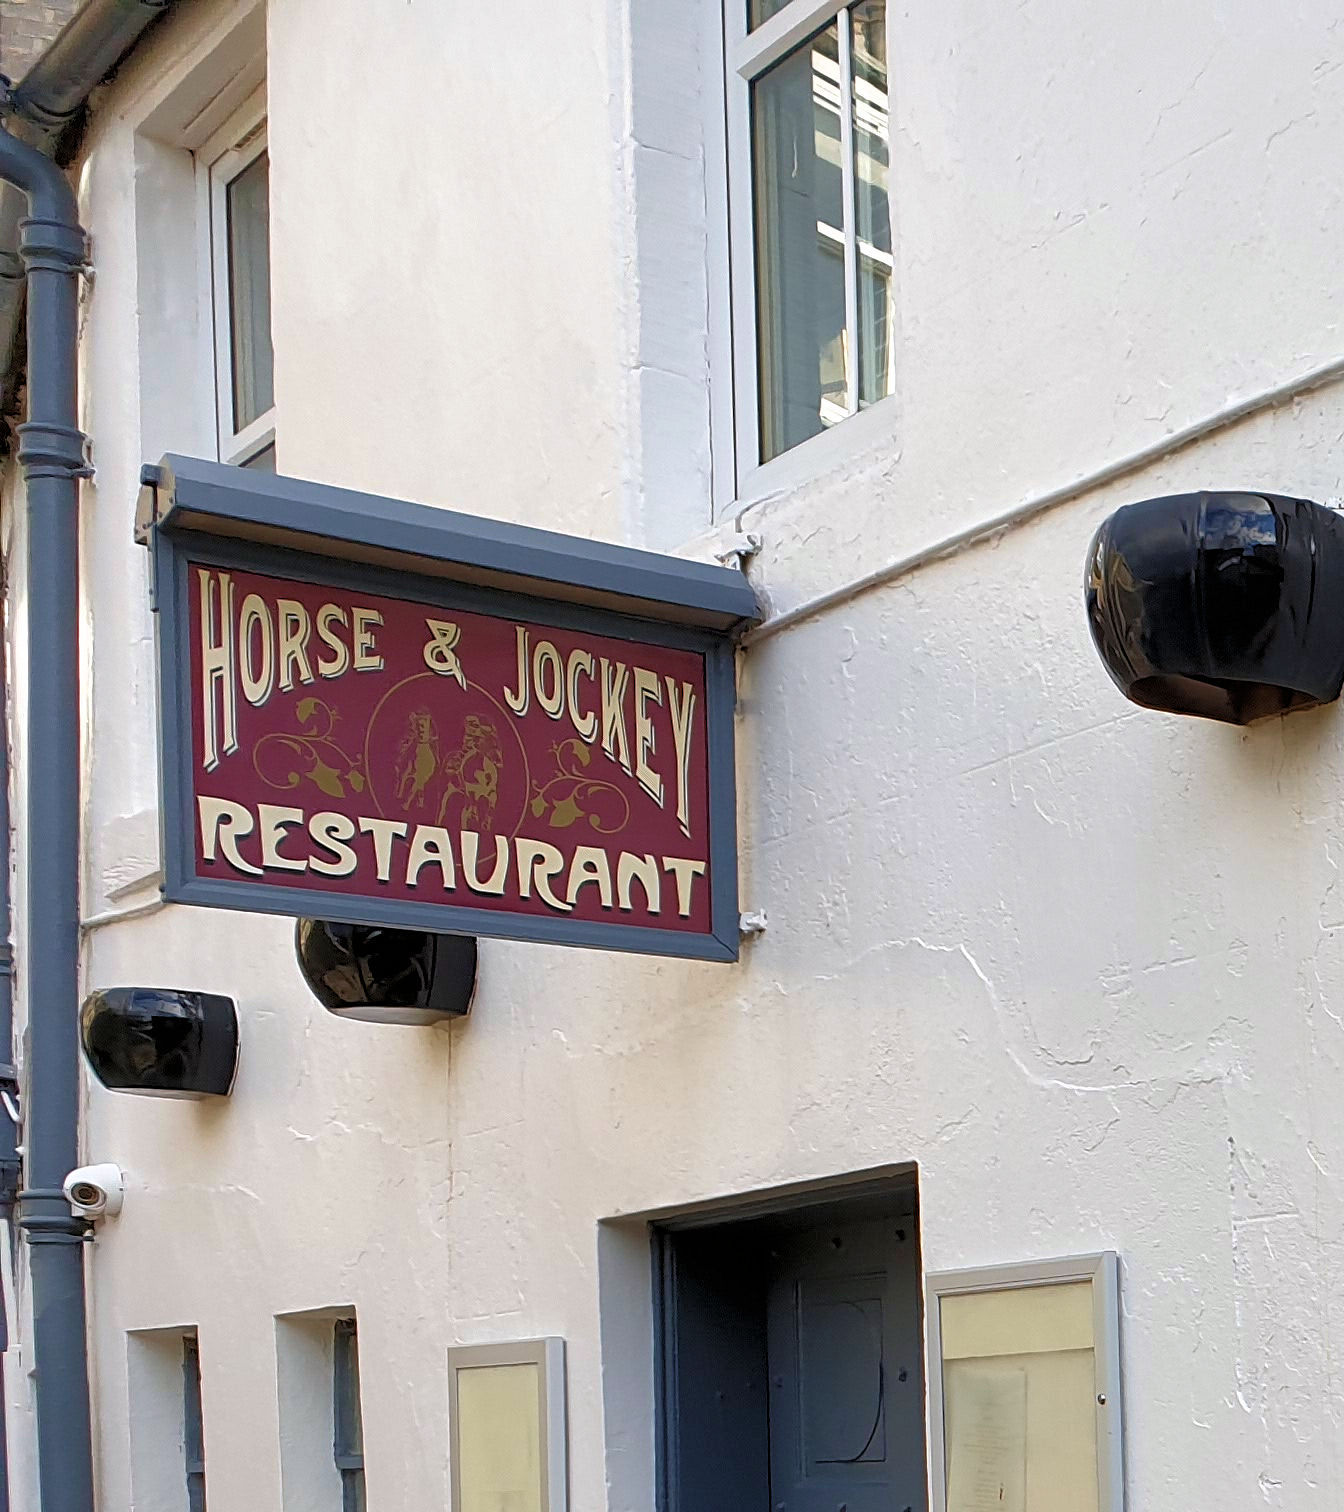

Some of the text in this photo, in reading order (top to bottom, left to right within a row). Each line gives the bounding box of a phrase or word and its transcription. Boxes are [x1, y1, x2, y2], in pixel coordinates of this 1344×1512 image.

[198, 568, 696, 839] HORSE & JOCKEY
[197, 795, 707, 917] RESTAURANT
